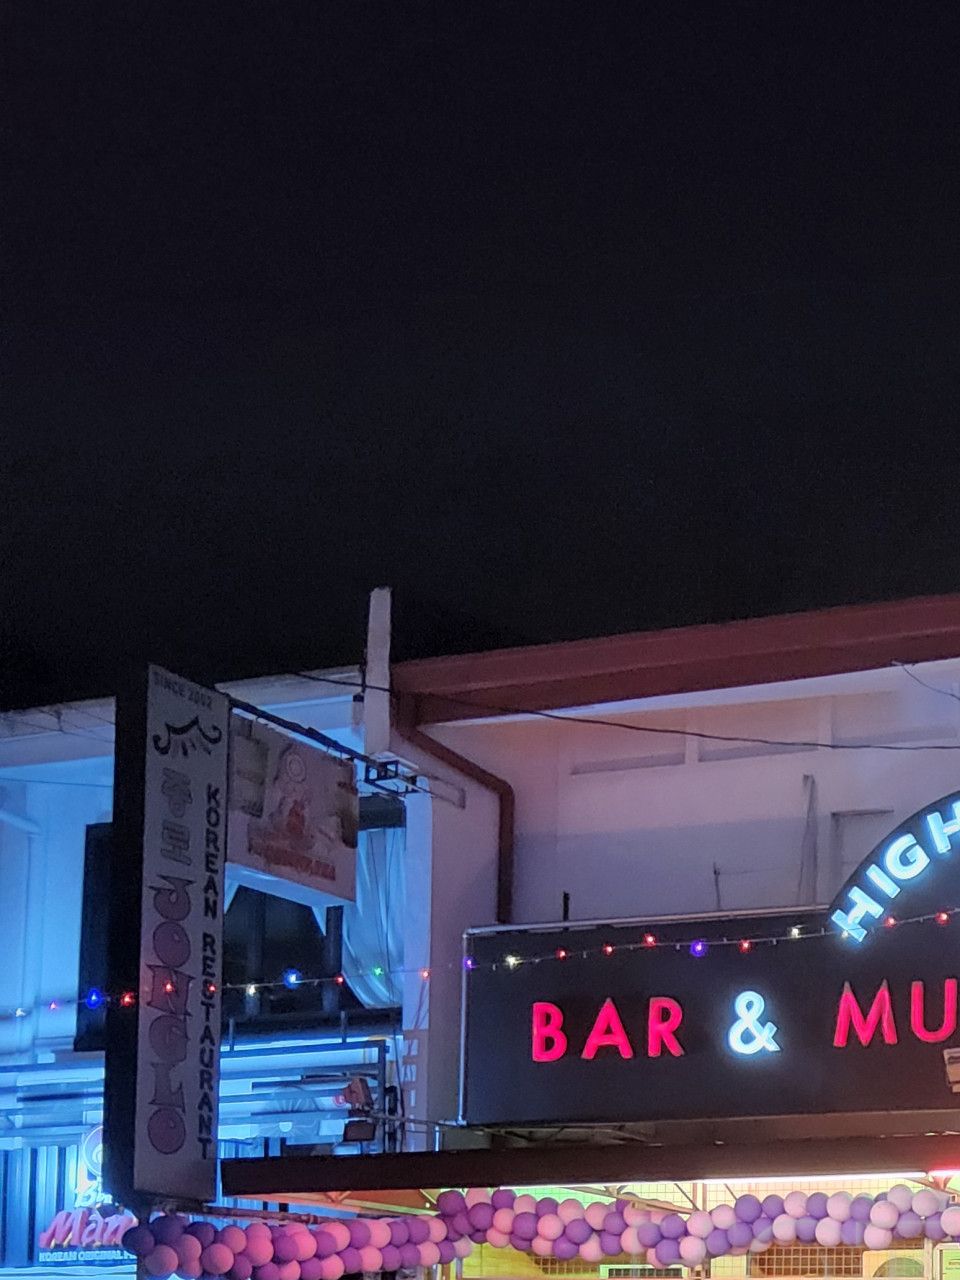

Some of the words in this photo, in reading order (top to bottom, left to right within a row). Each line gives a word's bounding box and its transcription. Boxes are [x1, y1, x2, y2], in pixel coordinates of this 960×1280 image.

[203, 783, 222, 919] KOREAN
[146, 874, 196, 1154] JONGLO
[196, 933, 217, 1161] RESTAURANT
[531, 997, 684, 1063] BAR
[727, 990, 780, 1056] &
